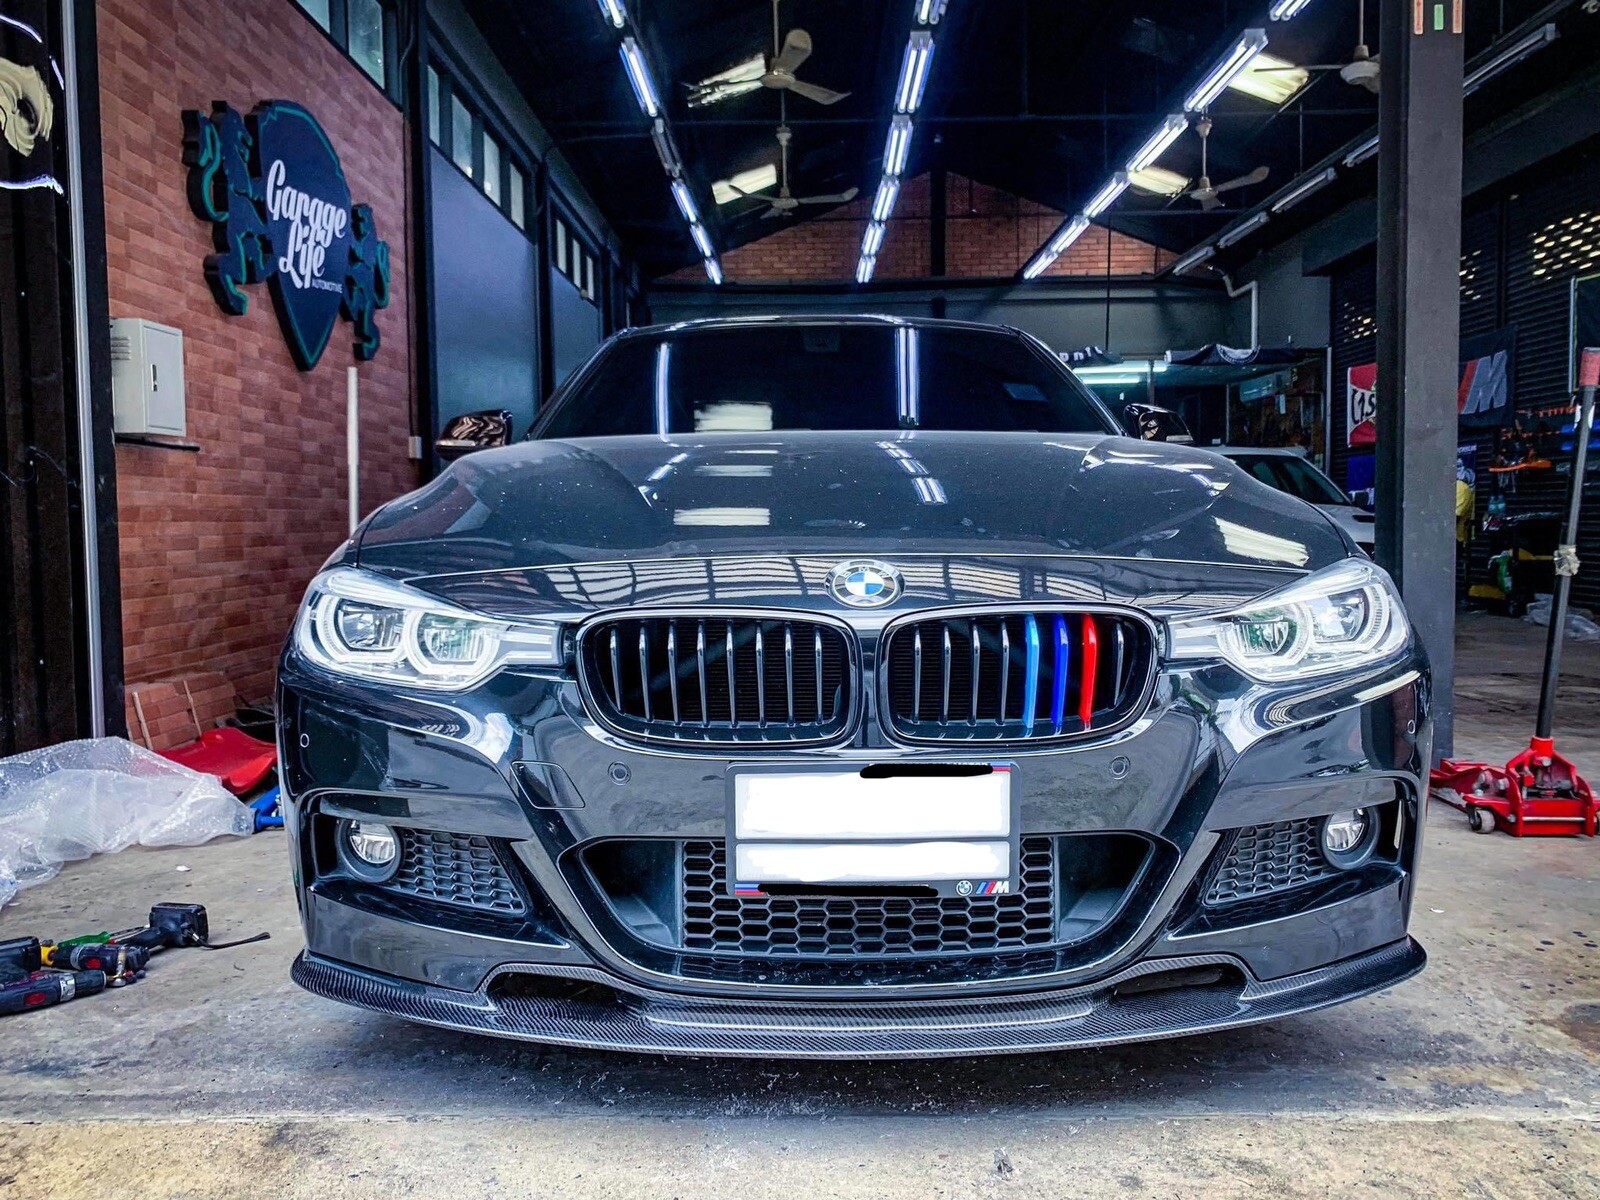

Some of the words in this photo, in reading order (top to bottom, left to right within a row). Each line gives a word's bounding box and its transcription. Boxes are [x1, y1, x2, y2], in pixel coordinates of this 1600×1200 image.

[266, 159, 347, 248] Garage
[279, 221, 325, 289] Life
[1461, 350, 1507, 415] M
[990, 881, 1010, 894] M
